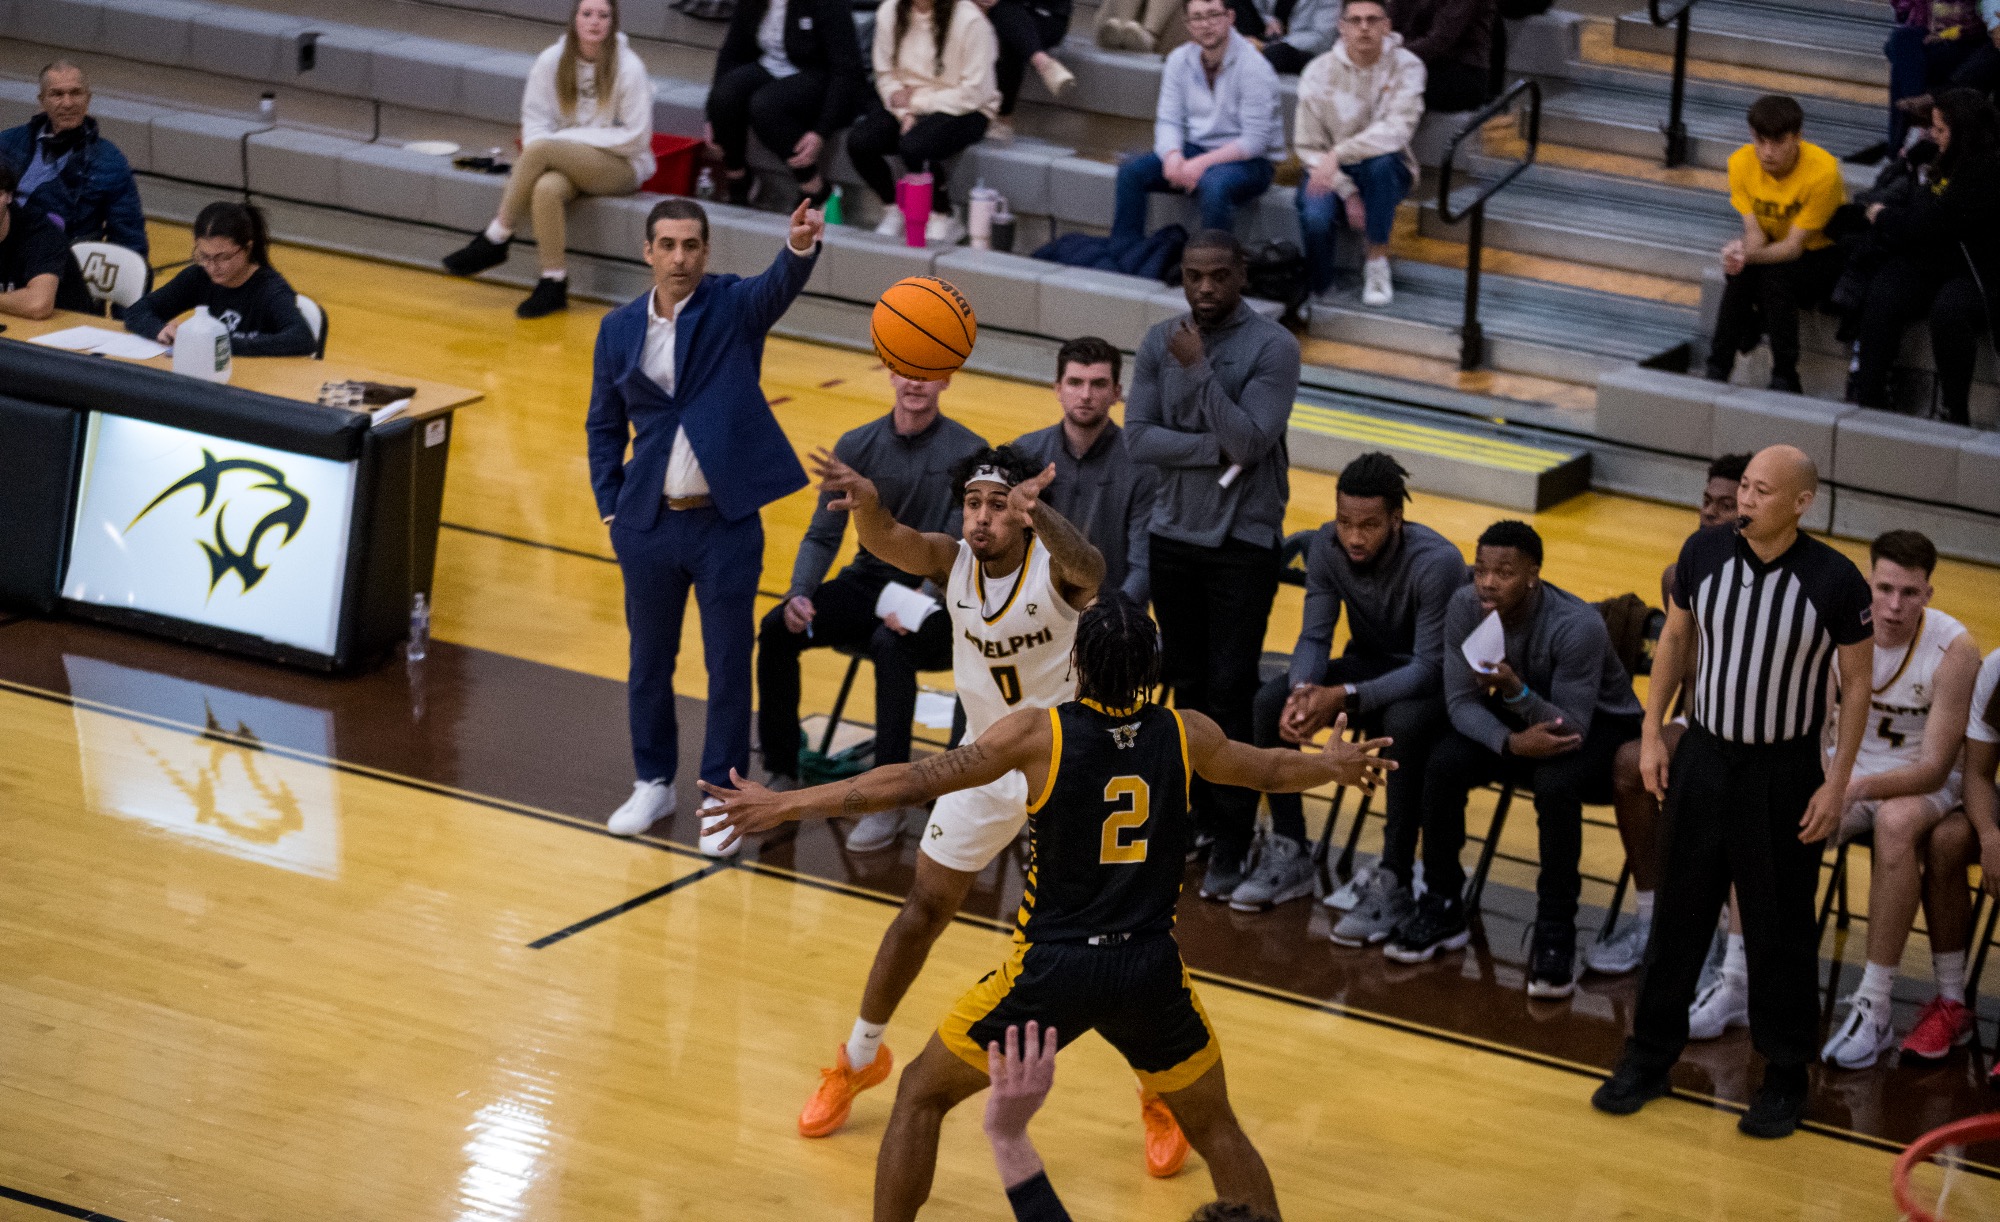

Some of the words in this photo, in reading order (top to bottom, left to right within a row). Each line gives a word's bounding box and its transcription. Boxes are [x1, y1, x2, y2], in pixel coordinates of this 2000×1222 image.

[83, 252, 119, 293] AU
[989, 664, 1023, 707] 0
[1878, 716, 1905, 749] 4
[1100, 774, 1150, 864] 2
